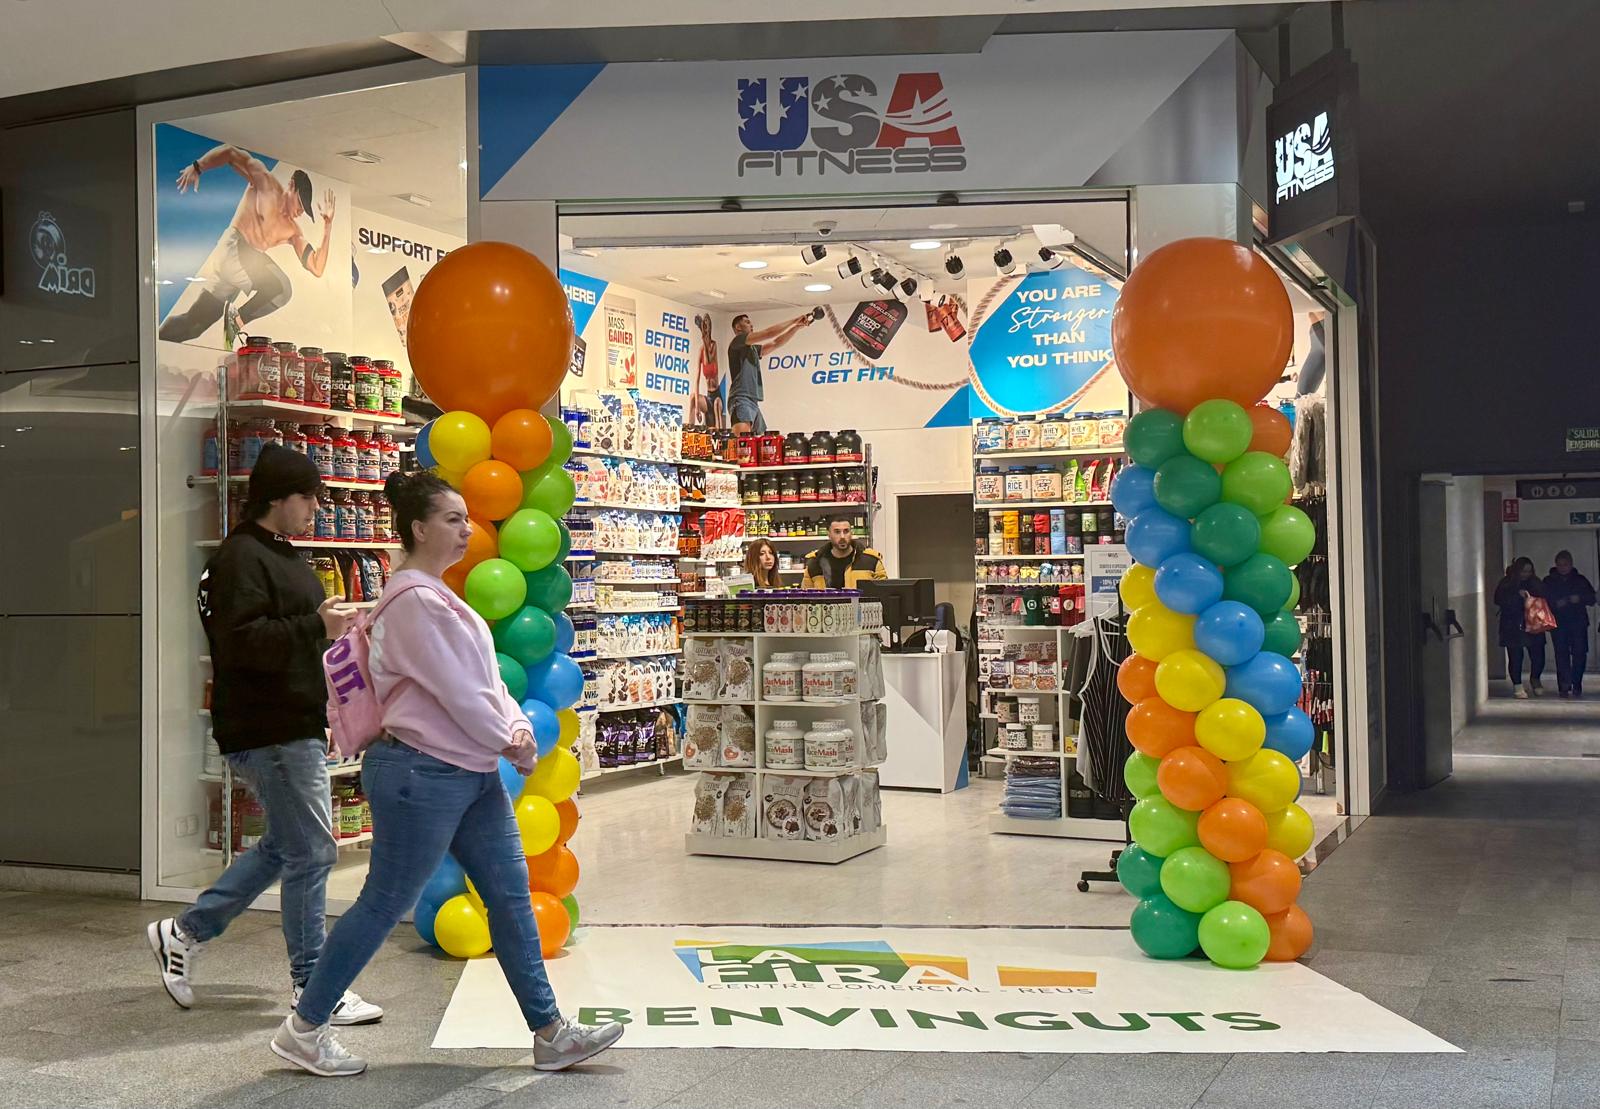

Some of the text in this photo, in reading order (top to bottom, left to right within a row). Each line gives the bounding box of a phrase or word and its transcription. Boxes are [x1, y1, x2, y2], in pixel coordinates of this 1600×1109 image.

[738, 72, 962, 153] USA
[1275, 111, 1334, 187] USA
[738, 147, 967, 177] FITNESS
[1276, 160, 1335, 205] FITNESS
[358, 227, 433, 262] SUPPORT
[1016, 284, 1102, 303] YOU ARE
[608, 316, 625, 330] MASS
[662, 312, 689, 333] FEEL
[859, 313, 881, 329] NITRO
[1008, 306, 1110, 333] Stronger
[608, 328, 634, 346] GAINER
[645, 329, 690, 353] BETTER
[1032, 331, 1085, 346] THAN
[655, 352, 690, 374] WORK
[768, 351, 854, 370] DON'T SIT
[1007, 349, 1114, 368] YOU THINK
[646, 372, 690, 396] BETTER
[811, 366, 895, 384] GET FIT!
[1007, 482, 1022, 490] RICE
[697, 949, 811, 965] LA
[827, 983, 990, 994] COMERCIAL
[1018, 987, 1093, 995] REUS
[577, 1005, 1282, 1033] BENVINGUTS
